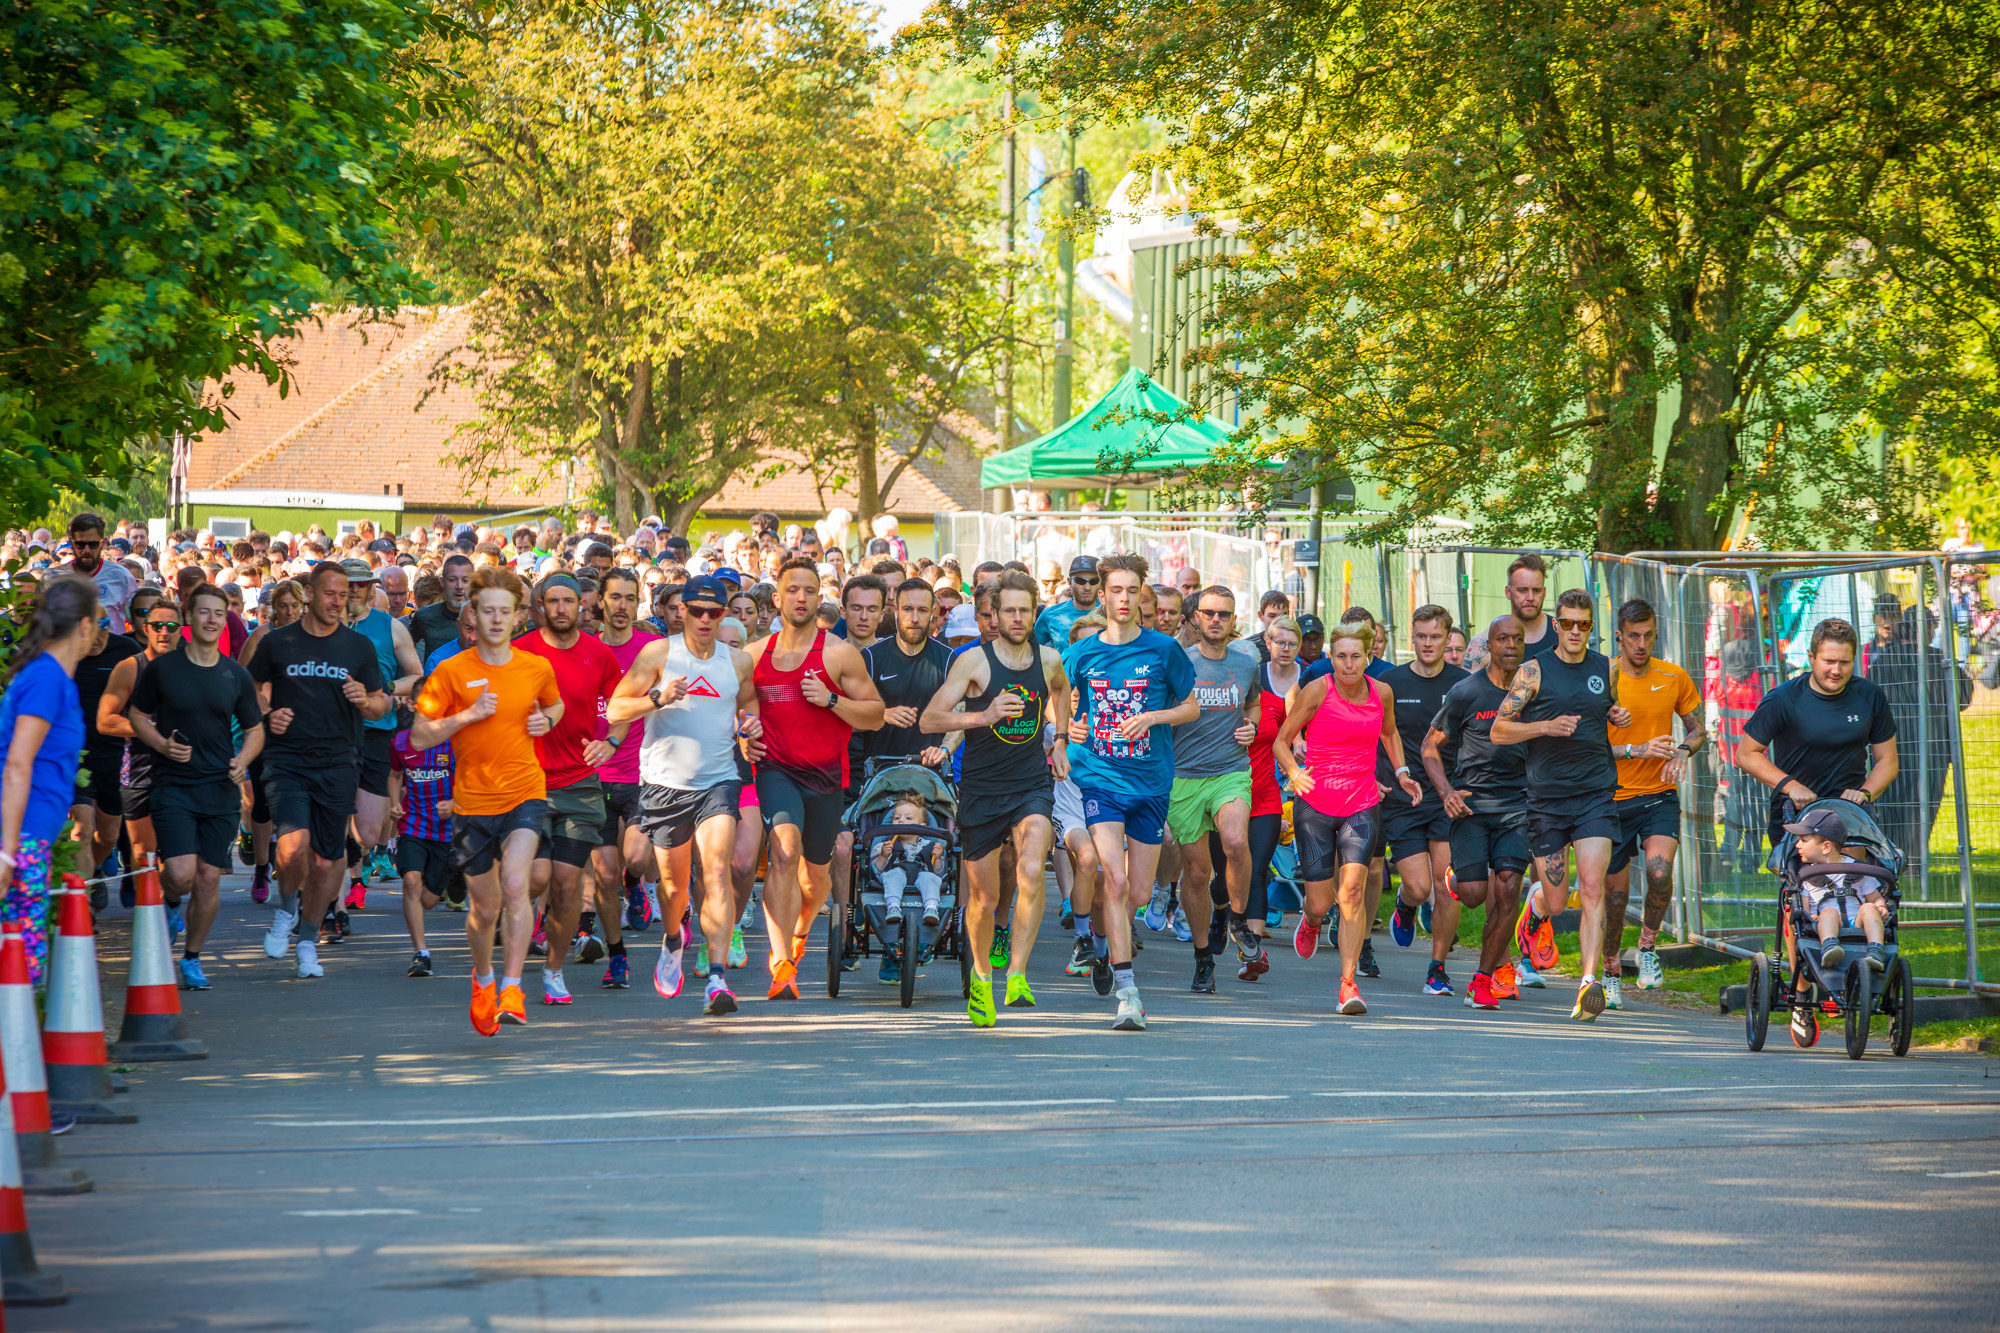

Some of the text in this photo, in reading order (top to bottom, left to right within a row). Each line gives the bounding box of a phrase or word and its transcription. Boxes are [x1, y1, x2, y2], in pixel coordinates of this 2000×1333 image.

[286, 661, 349, 680] adidas
[1135, 665, 1150, 675] 10K
[1106, 689, 1130, 701] 20
[1193, 687, 1230, 698] TOUGH
[1014, 718, 1036, 727] Local
[998, 726, 1035, 735] Runners
[405, 768, 449, 780] Rakuten
